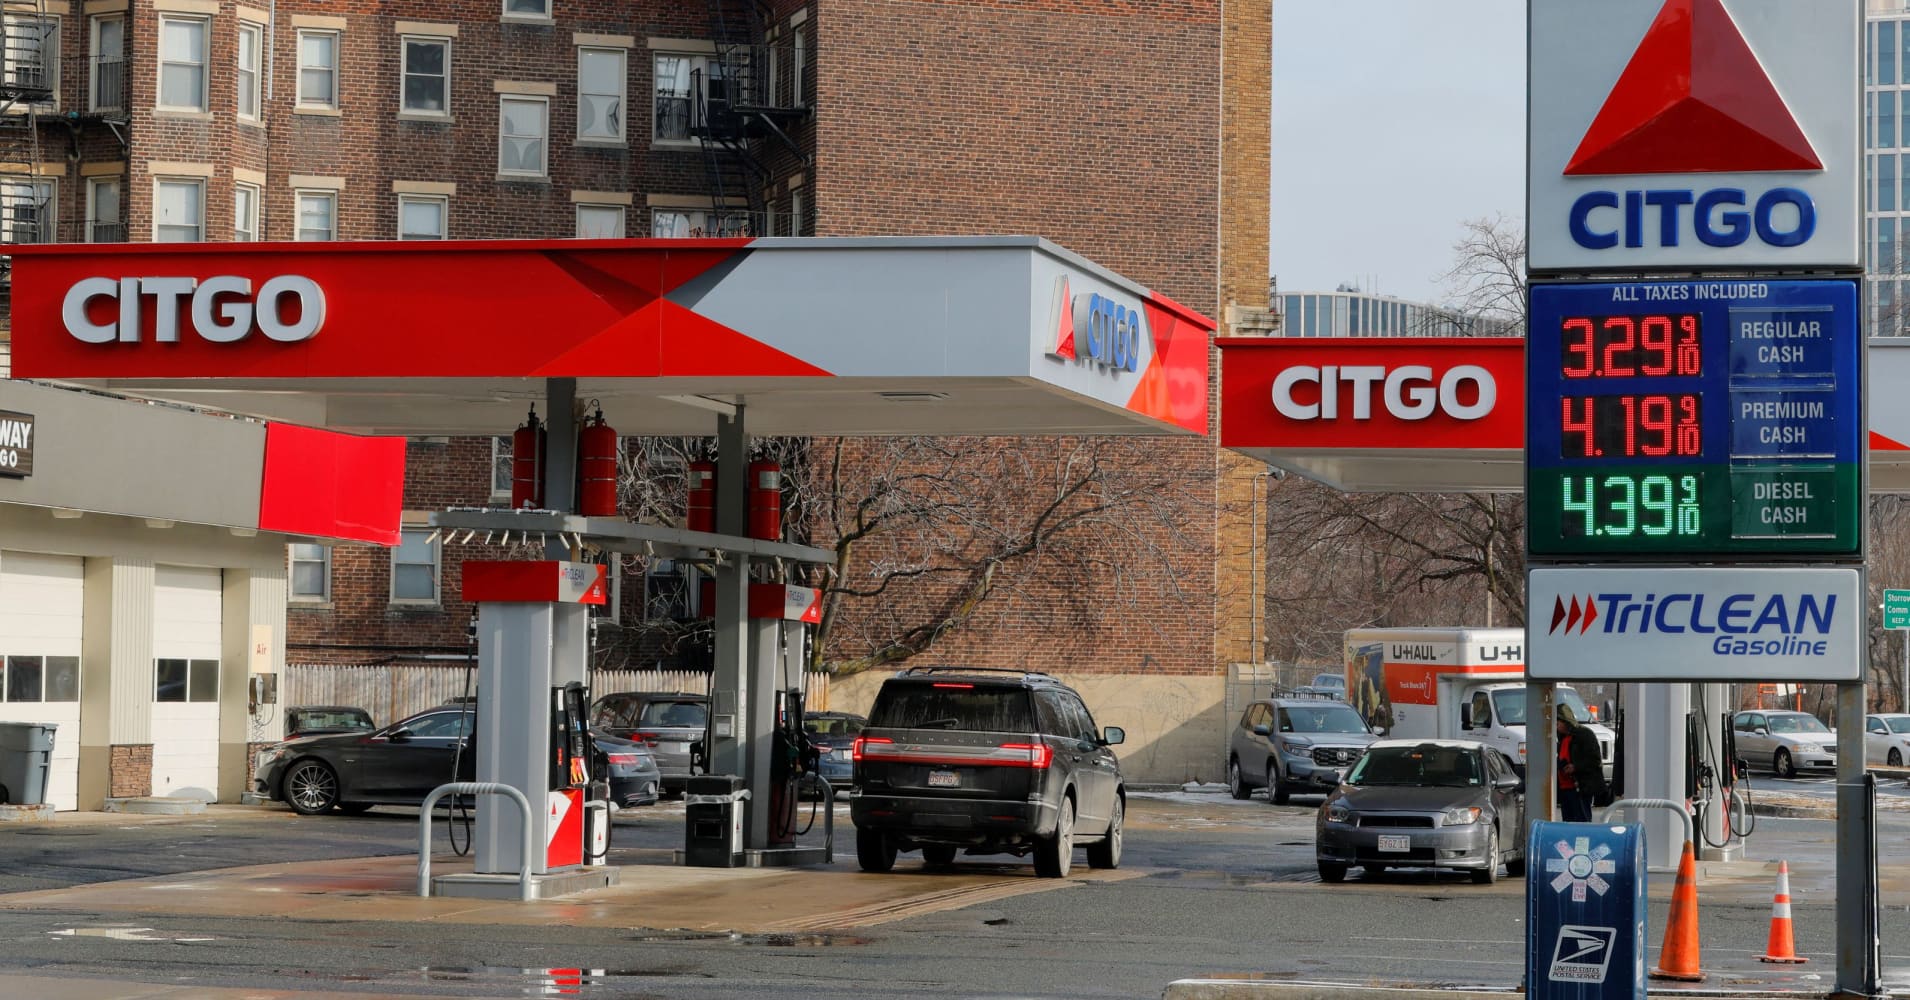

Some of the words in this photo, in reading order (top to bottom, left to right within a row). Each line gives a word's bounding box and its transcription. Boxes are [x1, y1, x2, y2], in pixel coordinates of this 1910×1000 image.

[1569, 187, 1817, 249] CITGO
[1612, 286, 1639, 301] ALL
[1644, 285, 1689, 300] TAXES
[1694, 284, 1768, 299] INCLUDED
[62, 275, 326, 343] CITGO
[1076, 292, 1140, 373] CITGO
[1741, 321, 1821, 339] REGULAR
[1563, 316, 1672, 377] 3.29
[1758, 346, 1804, 363] CASH
[1271, 365, 1497, 420] CITGO
[1742, 402, 1824, 419] PREMIUM
[1563, 396, 1672, 457] 4.19
[1760, 427, 1806, 444] CASH
[1754, 482, 1813, 500] DIESEL
[1563, 475, 1672, 535] 4.39
[1761, 506, 1807, 524] CASH
[1598, 594, 1837, 634] TriCLEAN
[256, 643, 267, 655] Air
[1393, 644, 1437, 660] U-HAUL
[1713, 636, 1828, 656] Gasoline
